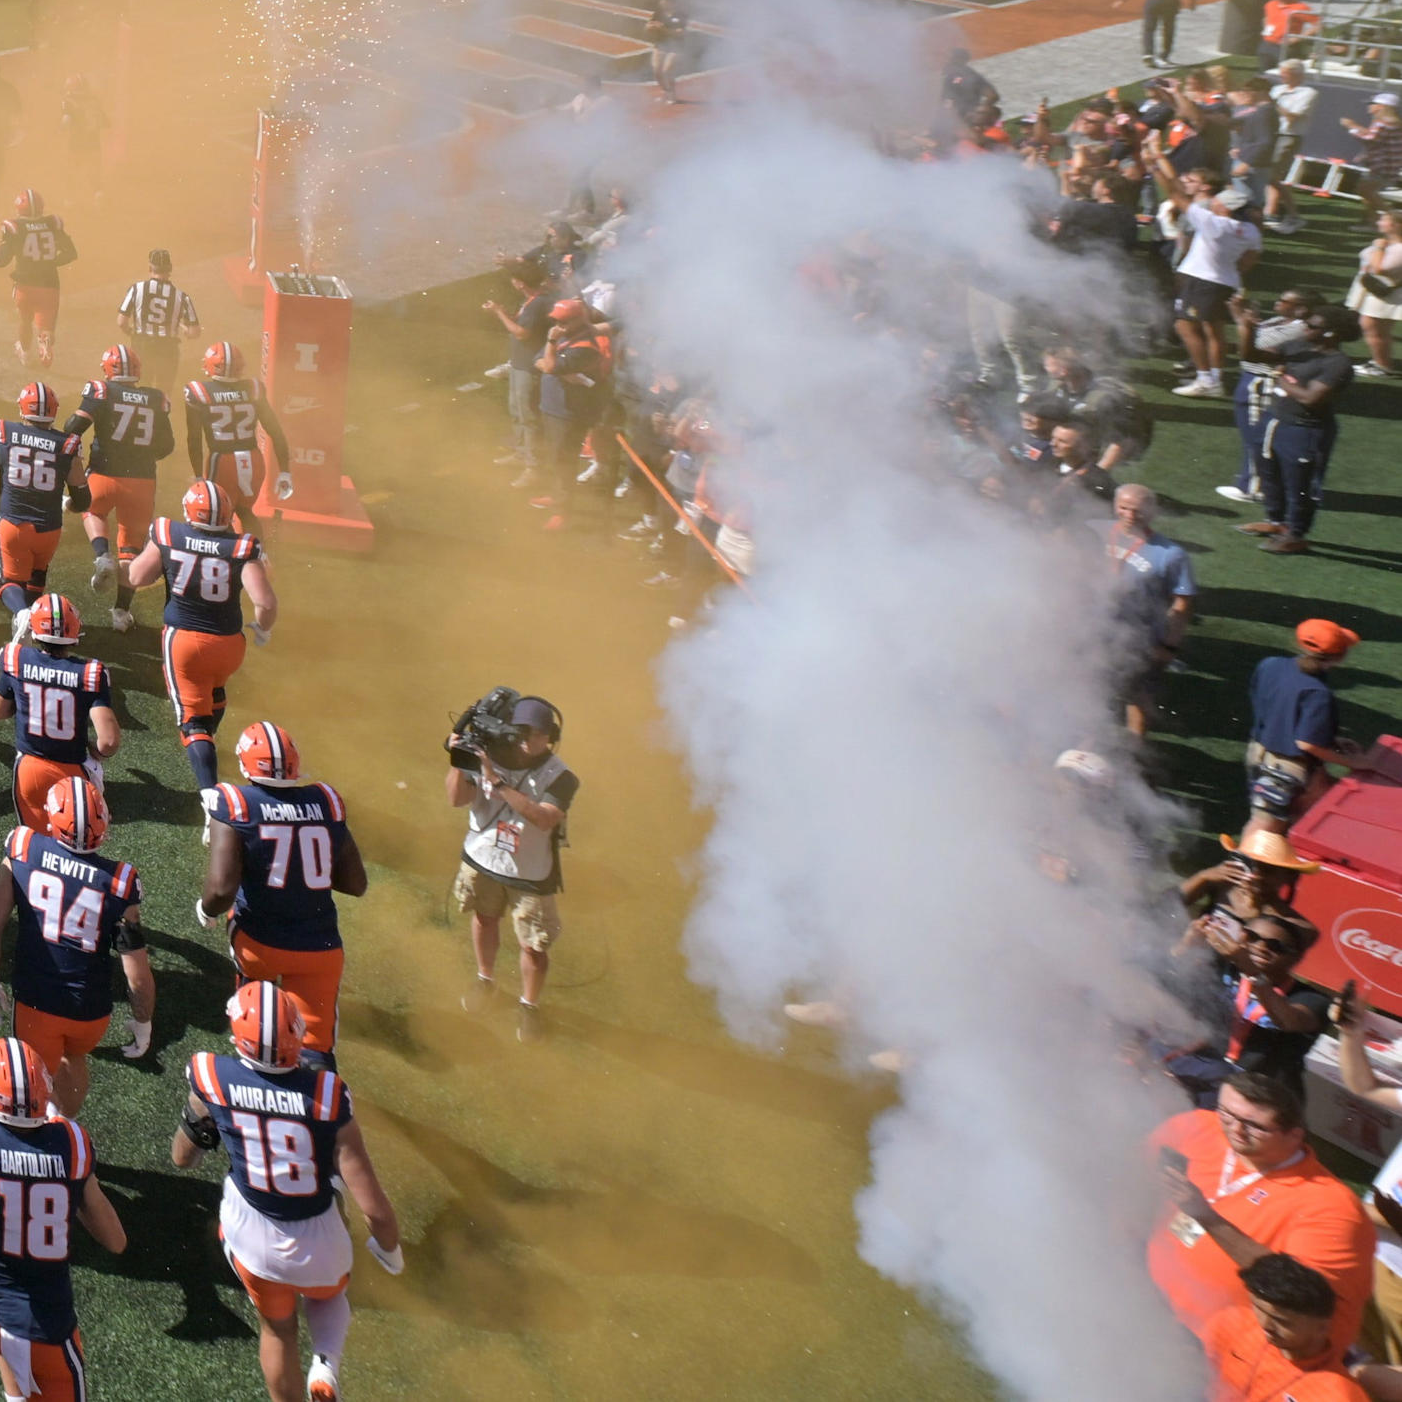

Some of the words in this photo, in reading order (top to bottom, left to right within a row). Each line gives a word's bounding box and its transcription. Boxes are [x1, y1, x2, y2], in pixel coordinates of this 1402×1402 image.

[22, 230, 56, 261] 43
[147, 297, 168, 324] S
[122, 390, 149, 406] GESKY
[111, 402, 155, 446] 73
[209, 403, 256, 441] 22
[20, 435, 56, 453] HANSEN
[185, 536, 221, 556] TUERK
[168, 549, 231, 603] 78
[22, 662, 79, 689] HAMPTON
[22, 682, 77, 741] 10
[259, 802, 325, 823] McMILLAN
[41, 850, 98, 884] HEWITT
[258, 824, 333, 890] 70
[27, 869, 105, 953] 94
[227, 1082, 306, 1115] MURAGIN
[0, 1149, 66, 1180] BARTOLOTTA
[230, 1108, 319, 1197] 18
